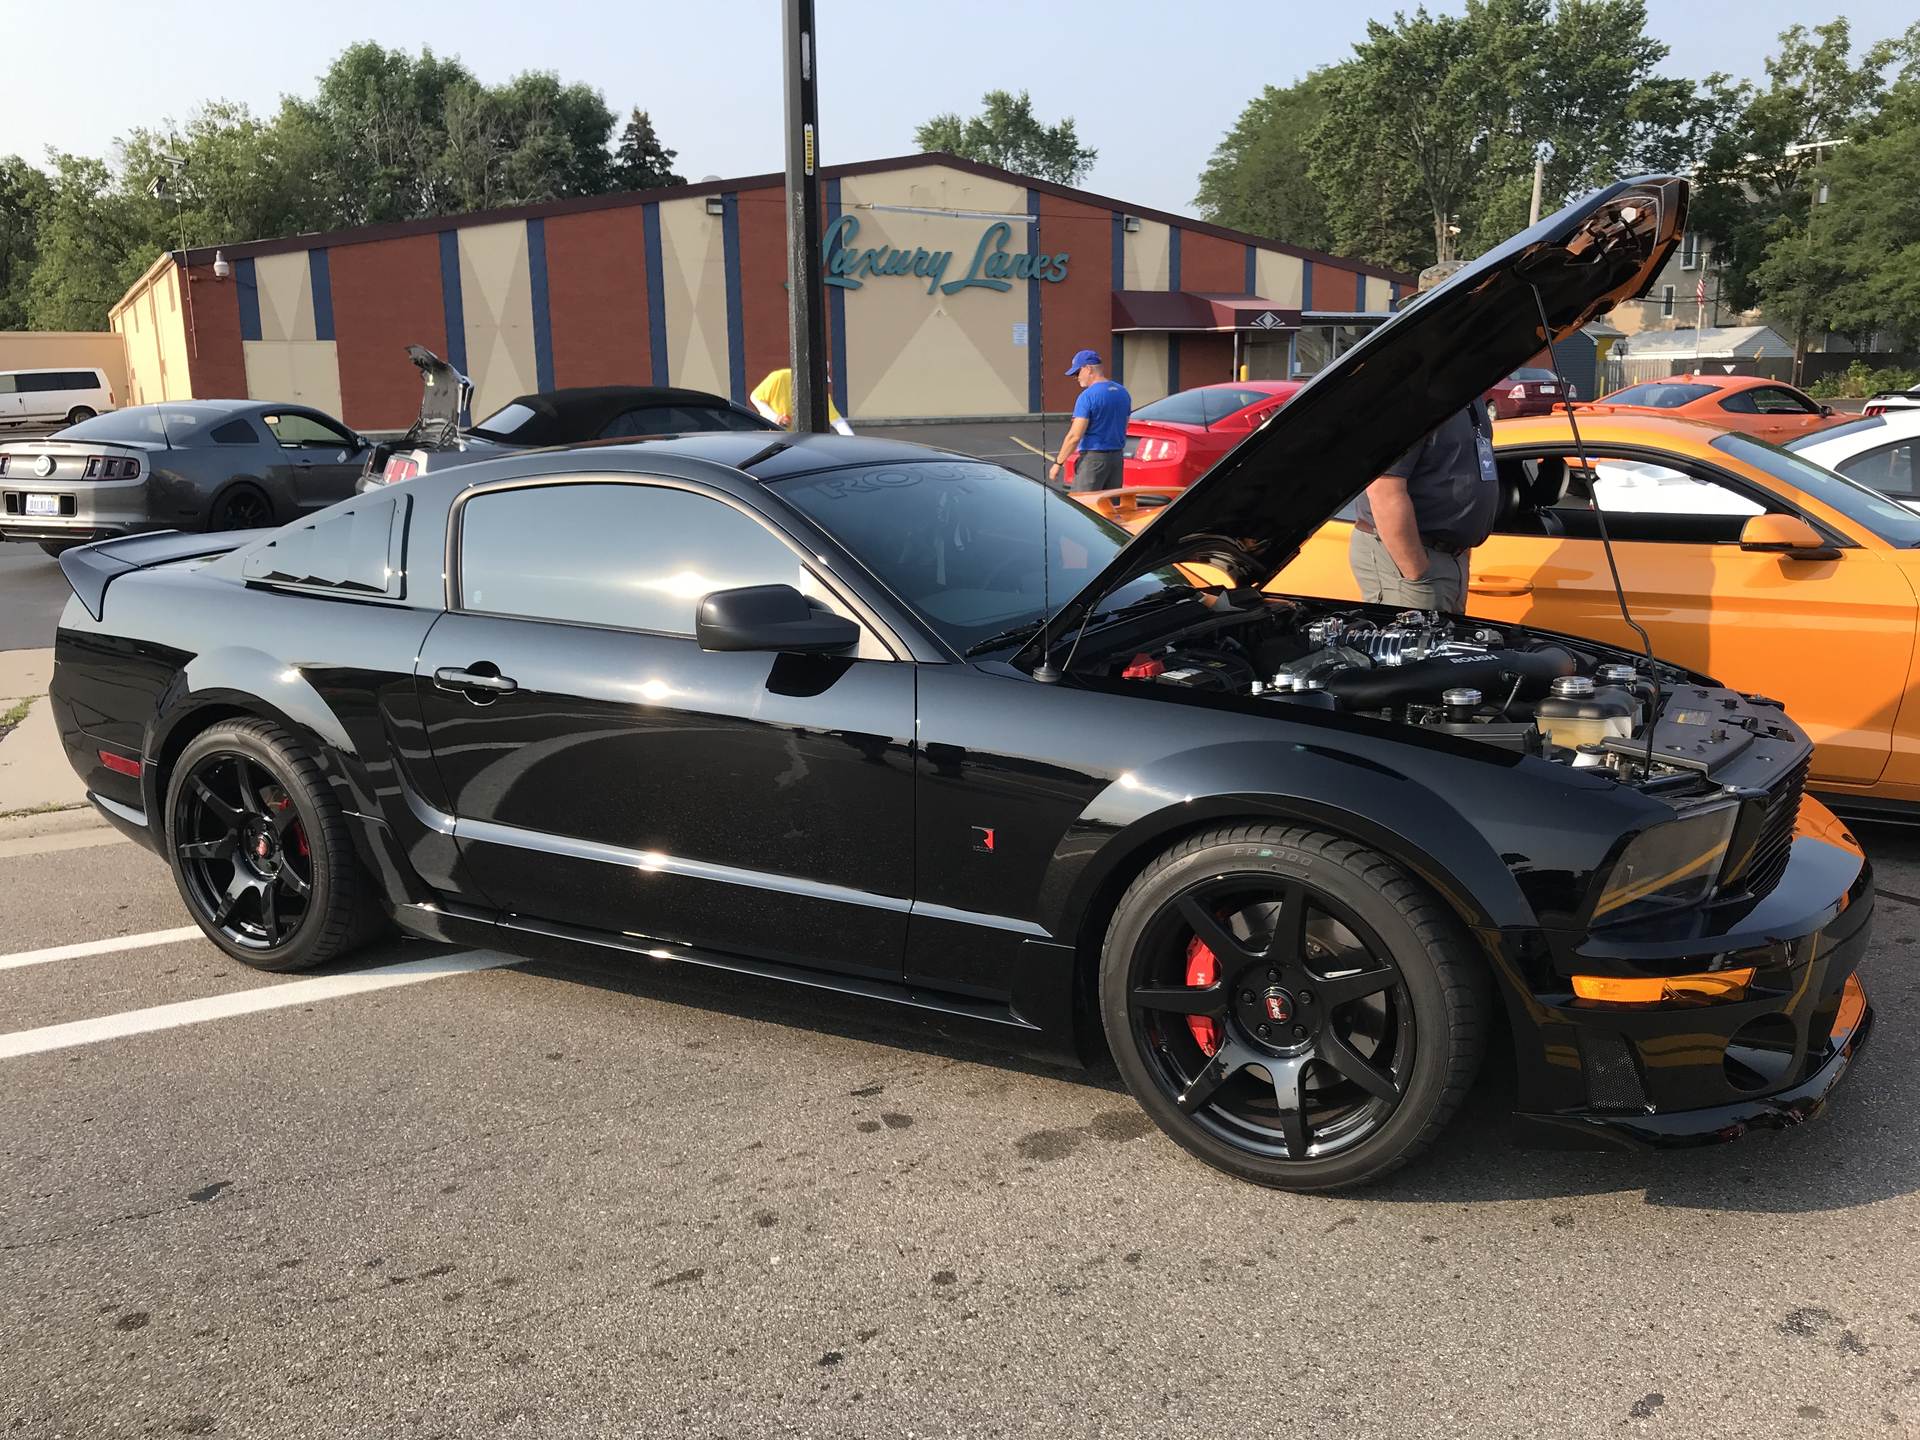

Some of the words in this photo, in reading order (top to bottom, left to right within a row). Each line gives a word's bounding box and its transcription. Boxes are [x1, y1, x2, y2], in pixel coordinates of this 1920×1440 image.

[785, 215, 952, 295] Luxury
[941, 221, 1070, 297] Lanes
[1449, 654, 1500, 664] ROUSH
